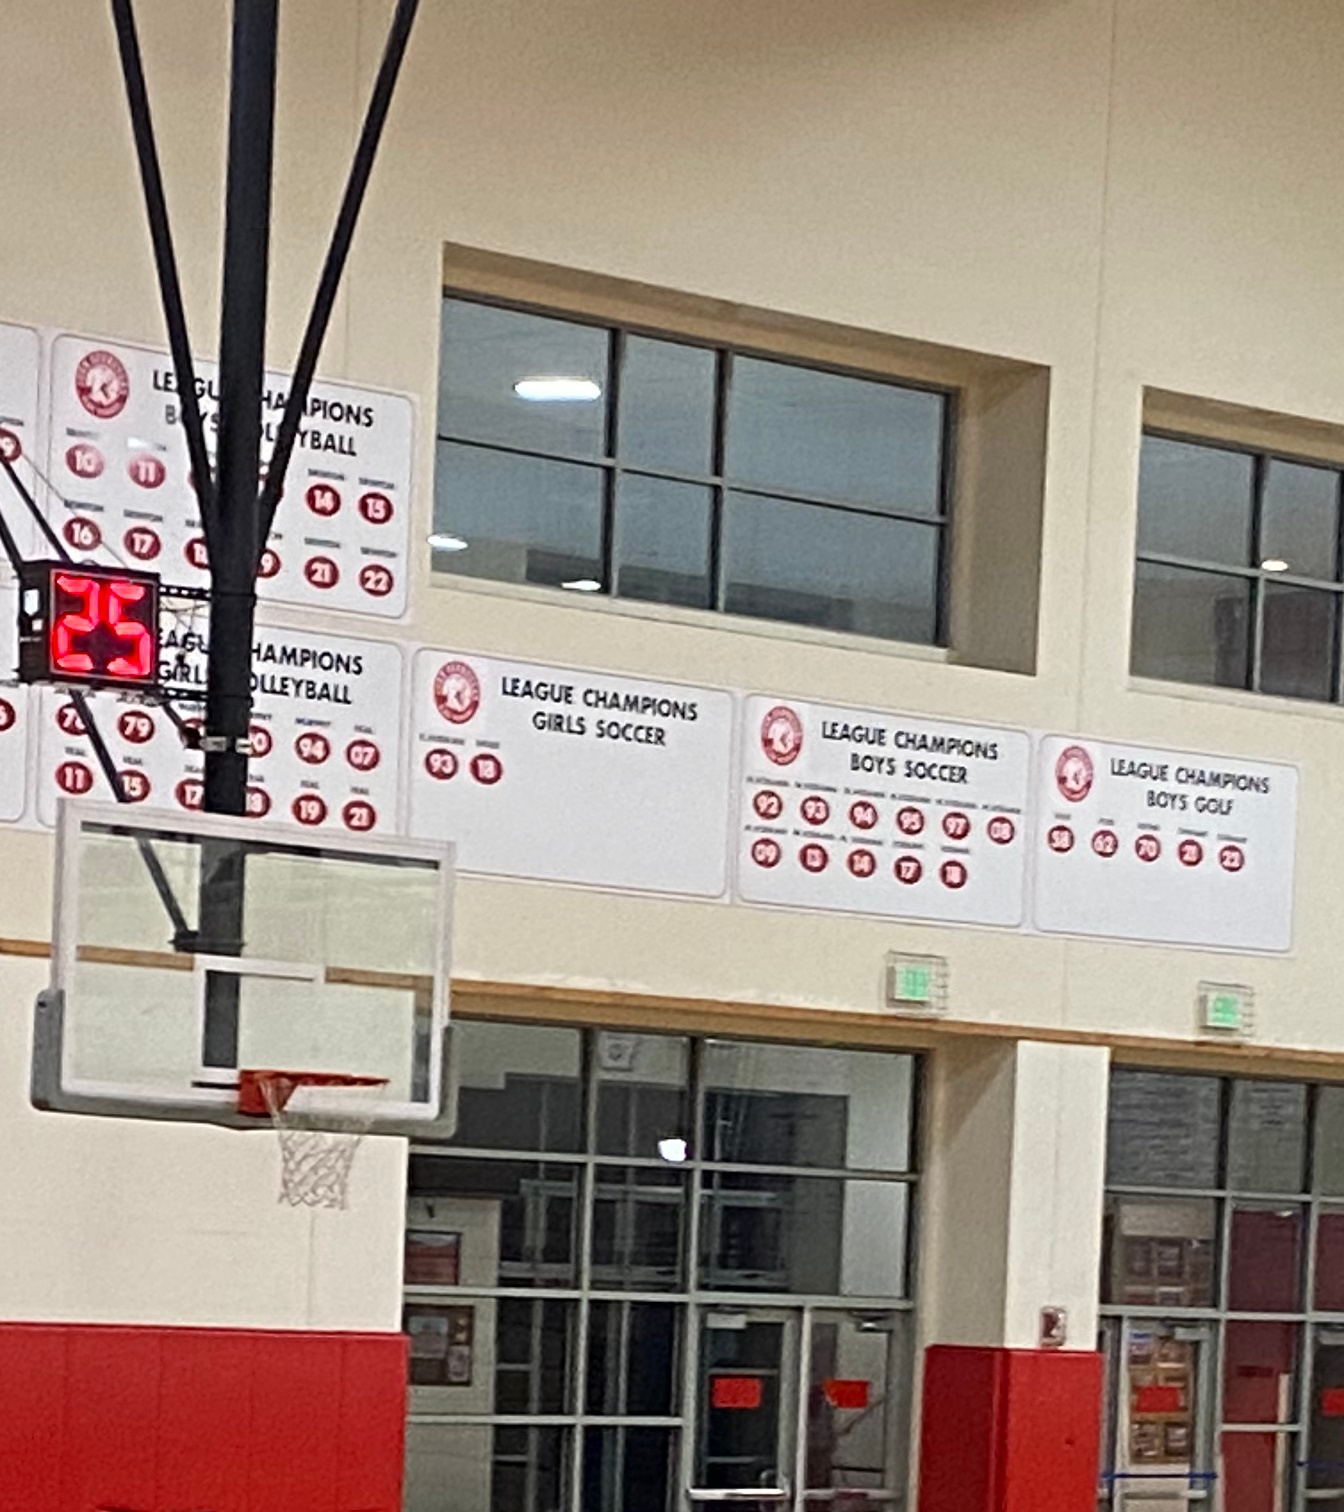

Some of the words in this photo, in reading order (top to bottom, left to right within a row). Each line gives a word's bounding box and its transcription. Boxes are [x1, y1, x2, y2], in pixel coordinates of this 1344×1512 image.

[137, 460, 155, 482] 11
[72, 522, 93, 545] 16
[132, 533, 154, 554] 17
[311, 561, 331, 583] 21
[364, 570, 388, 591] 22
[56, 575, 151, 676] 25
[253, 643, 364, 676] HAMPIONS
[158, 661, 208, 685] GIRL
[251, 673, 353, 705] OLLEYBALL
[502, 677, 574, 705] LEAGUE
[583, 688, 698, 722] CHAMPIONS
[124, 716, 149, 738] 79
[299, 738, 325, 760] 94
[532, 711, 586, 736] GIRLS
[596, 719, 666, 747] SOCCER
[821, 721, 886, 747] LEAGUE
[894, 731, 998, 760] CHAMPIONS
[429, 753, 454, 774] 93
[850, 753, 896, 776] BOYS
[905, 763, 968, 784] SOCCER
[1110, 757, 1169, 782] LEAGUE
[1174, 767, 1271, 795] CHAMPIONS
[64, 767, 85, 789] 11
[122, 776, 143, 797] 15
[299, 800, 320, 820] 19
[1146, 790, 1187, 811] BOYS
[1195, 796, 1235, 816] GOLF
